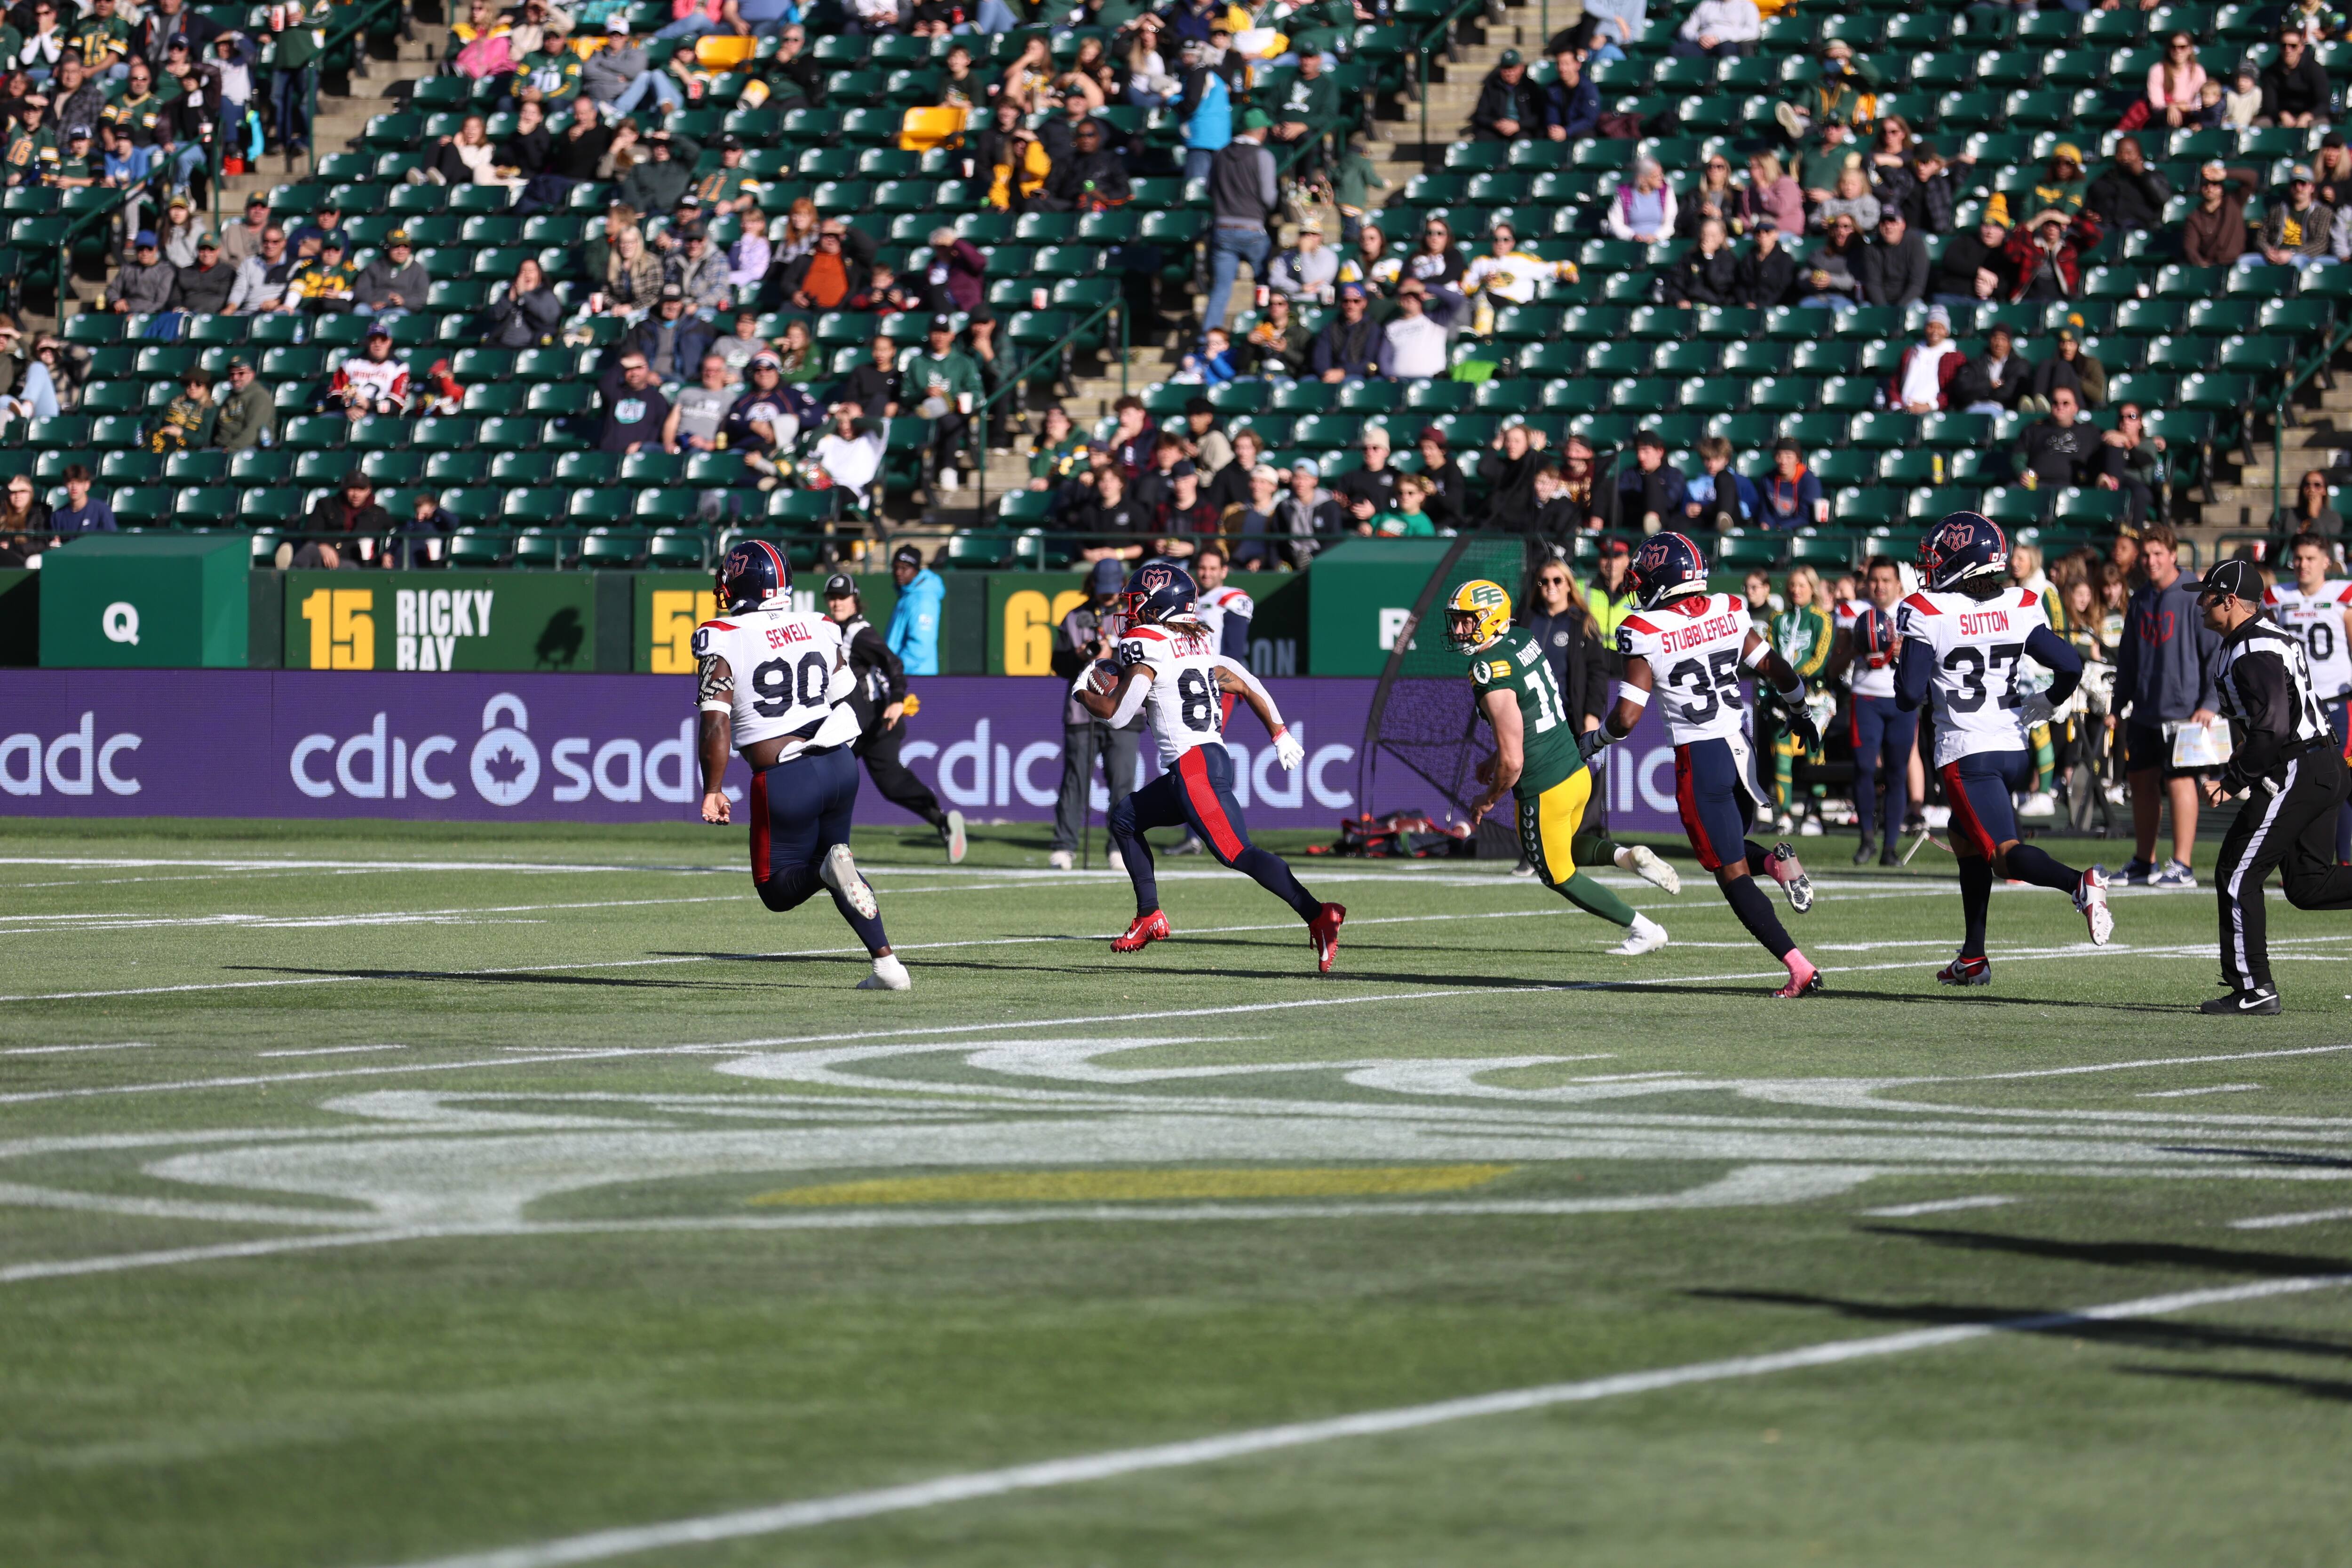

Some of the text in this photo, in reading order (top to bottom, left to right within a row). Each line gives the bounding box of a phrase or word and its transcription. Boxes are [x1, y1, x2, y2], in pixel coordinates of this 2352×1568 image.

[103, 601, 140, 646] Q
[302, 589, 374, 670] 15
[396, 589, 494, 637] RICKY
[1661, 613, 1739, 654] STUBBLEFIELD
[1959, 610, 2009, 636] SUTTON
[396, 635, 456, 671] RAY
[765, 622, 812, 650] SEWELL
[1120, 640, 1145, 664] 89
[1615, 629, 1633, 653] 35
[752, 652, 829, 718] 90
[1668, 648, 1741, 725] 35
[1943, 643, 2025, 713] 37
